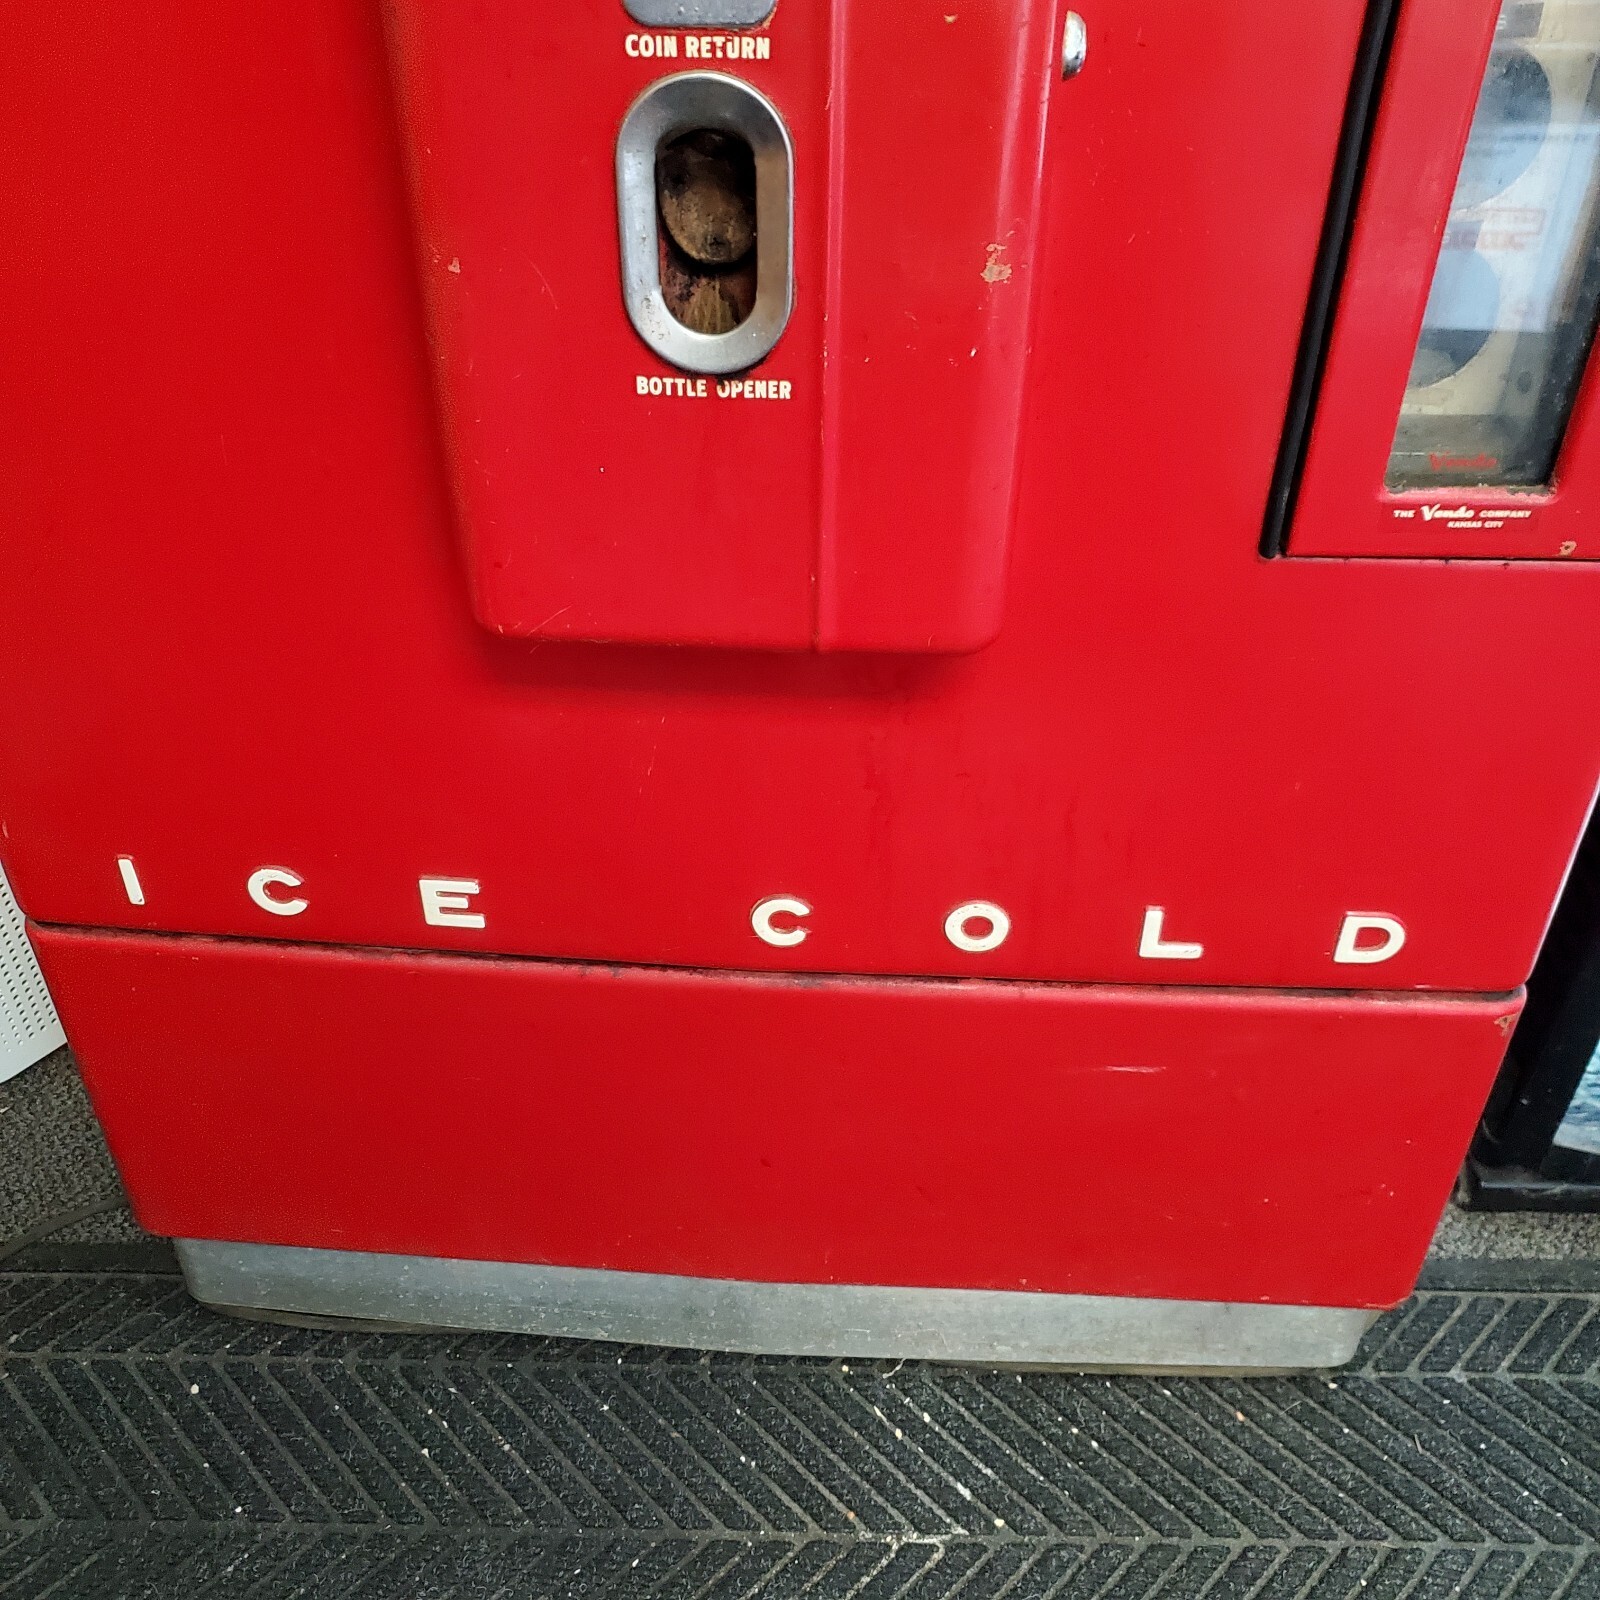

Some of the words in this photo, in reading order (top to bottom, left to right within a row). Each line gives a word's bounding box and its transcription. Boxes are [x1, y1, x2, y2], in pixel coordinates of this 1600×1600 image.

[624, 33, 678, 58] COIN
[684, 35, 771, 60] RETURN
[636, 375, 708, 398] BOTTLE
[716, 379, 792, 400] OPENER
[1392, 508, 1416, 519] THE
[1420, 503, 1475, 522] Vendo
[1478, 509, 1532, 519] COMPANY
[1446, 520, 1483, 529] KANSAS
[1483, 520, 1504, 529] CITY
[117, 857, 487, 929] ICE
[749, 894, 1407, 965] COLD
